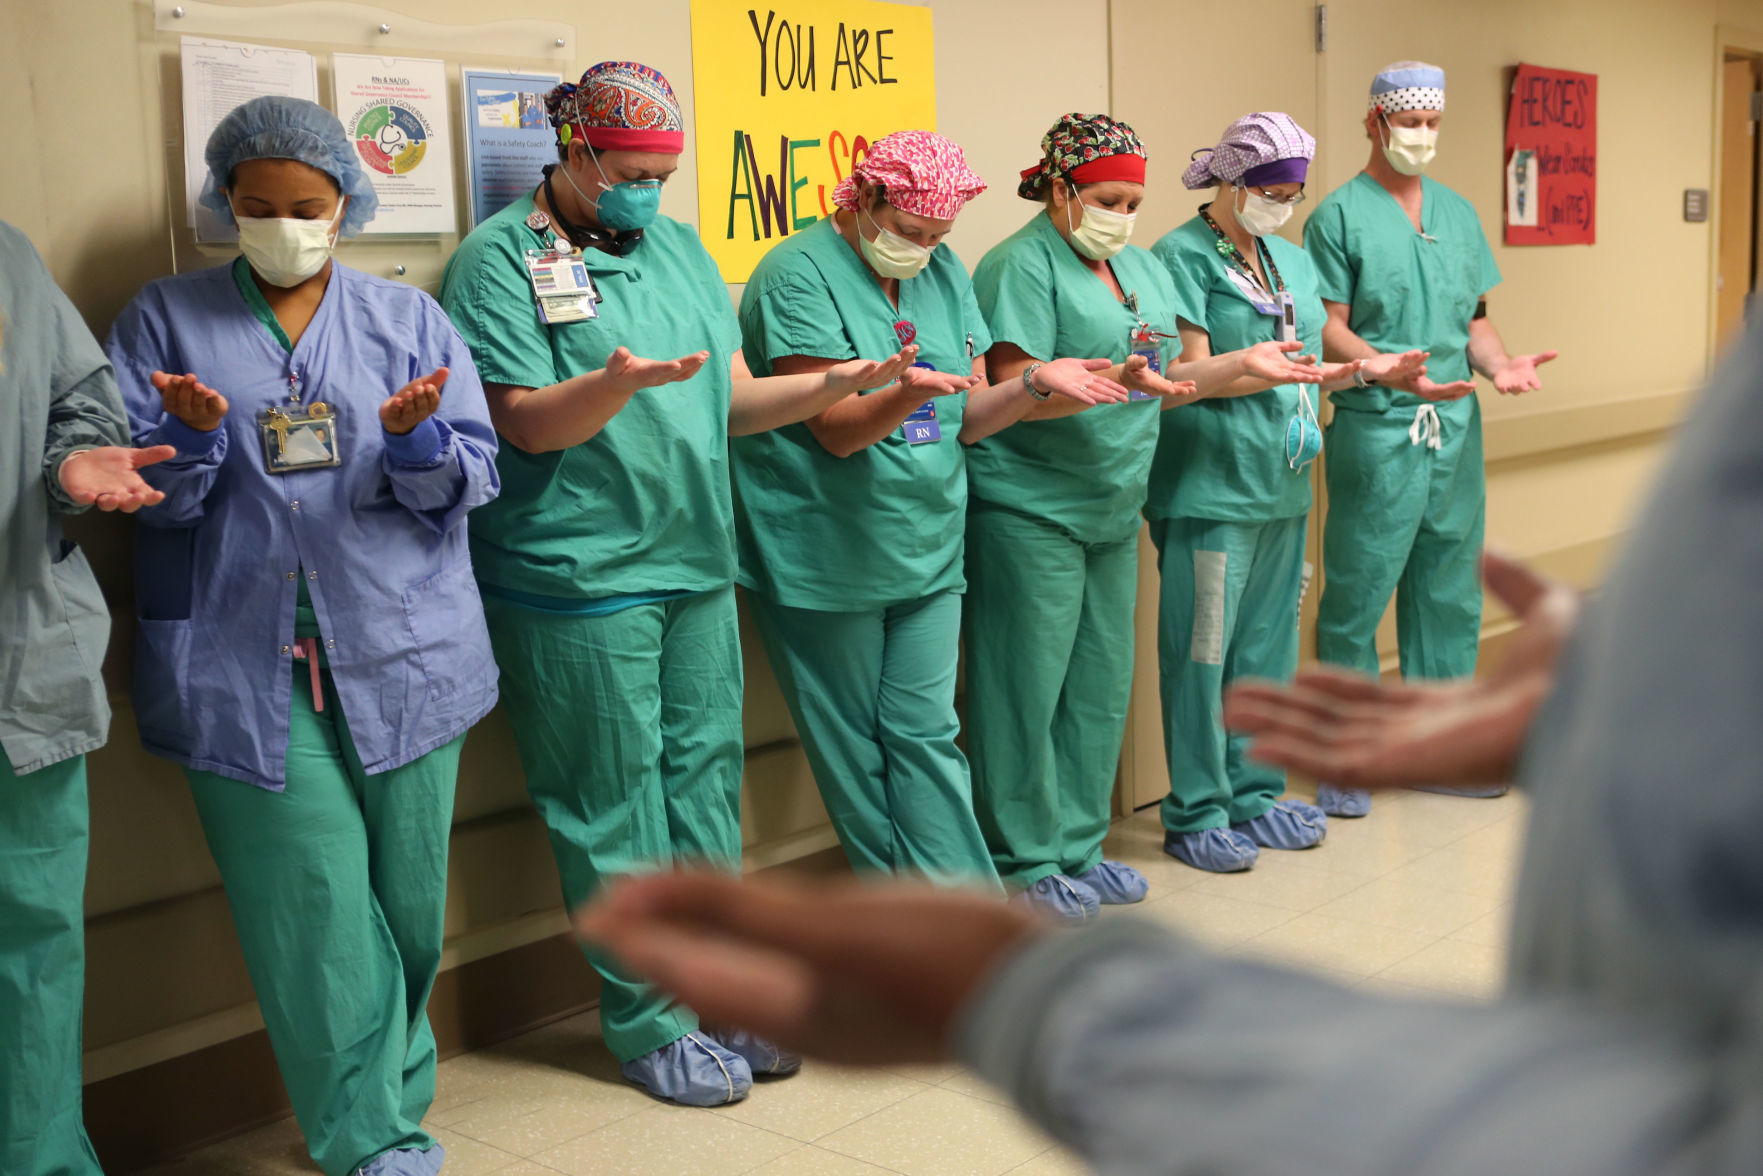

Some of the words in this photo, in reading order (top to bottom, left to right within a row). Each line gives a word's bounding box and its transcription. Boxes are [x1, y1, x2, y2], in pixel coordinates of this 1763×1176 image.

[748, 10, 816, 97] YOU
[831, 22, 898, 91] ARE
[371, 76, 382, 84] RNs
[348, 106, 367, 137] NURSING
[366, 98, 395, 110] SHARED
[397, 99, 434, 138] GOVERNANCE
[1519, 76, 1588, 130] HEROES
[508, 140, 525, 148] Safety
[526, 140, 547, 148] Coach?
[1535, 144, 1561, 177] Wear
[727, 130, 878, 241] AWES
[915, 427, 930, 439] RN
